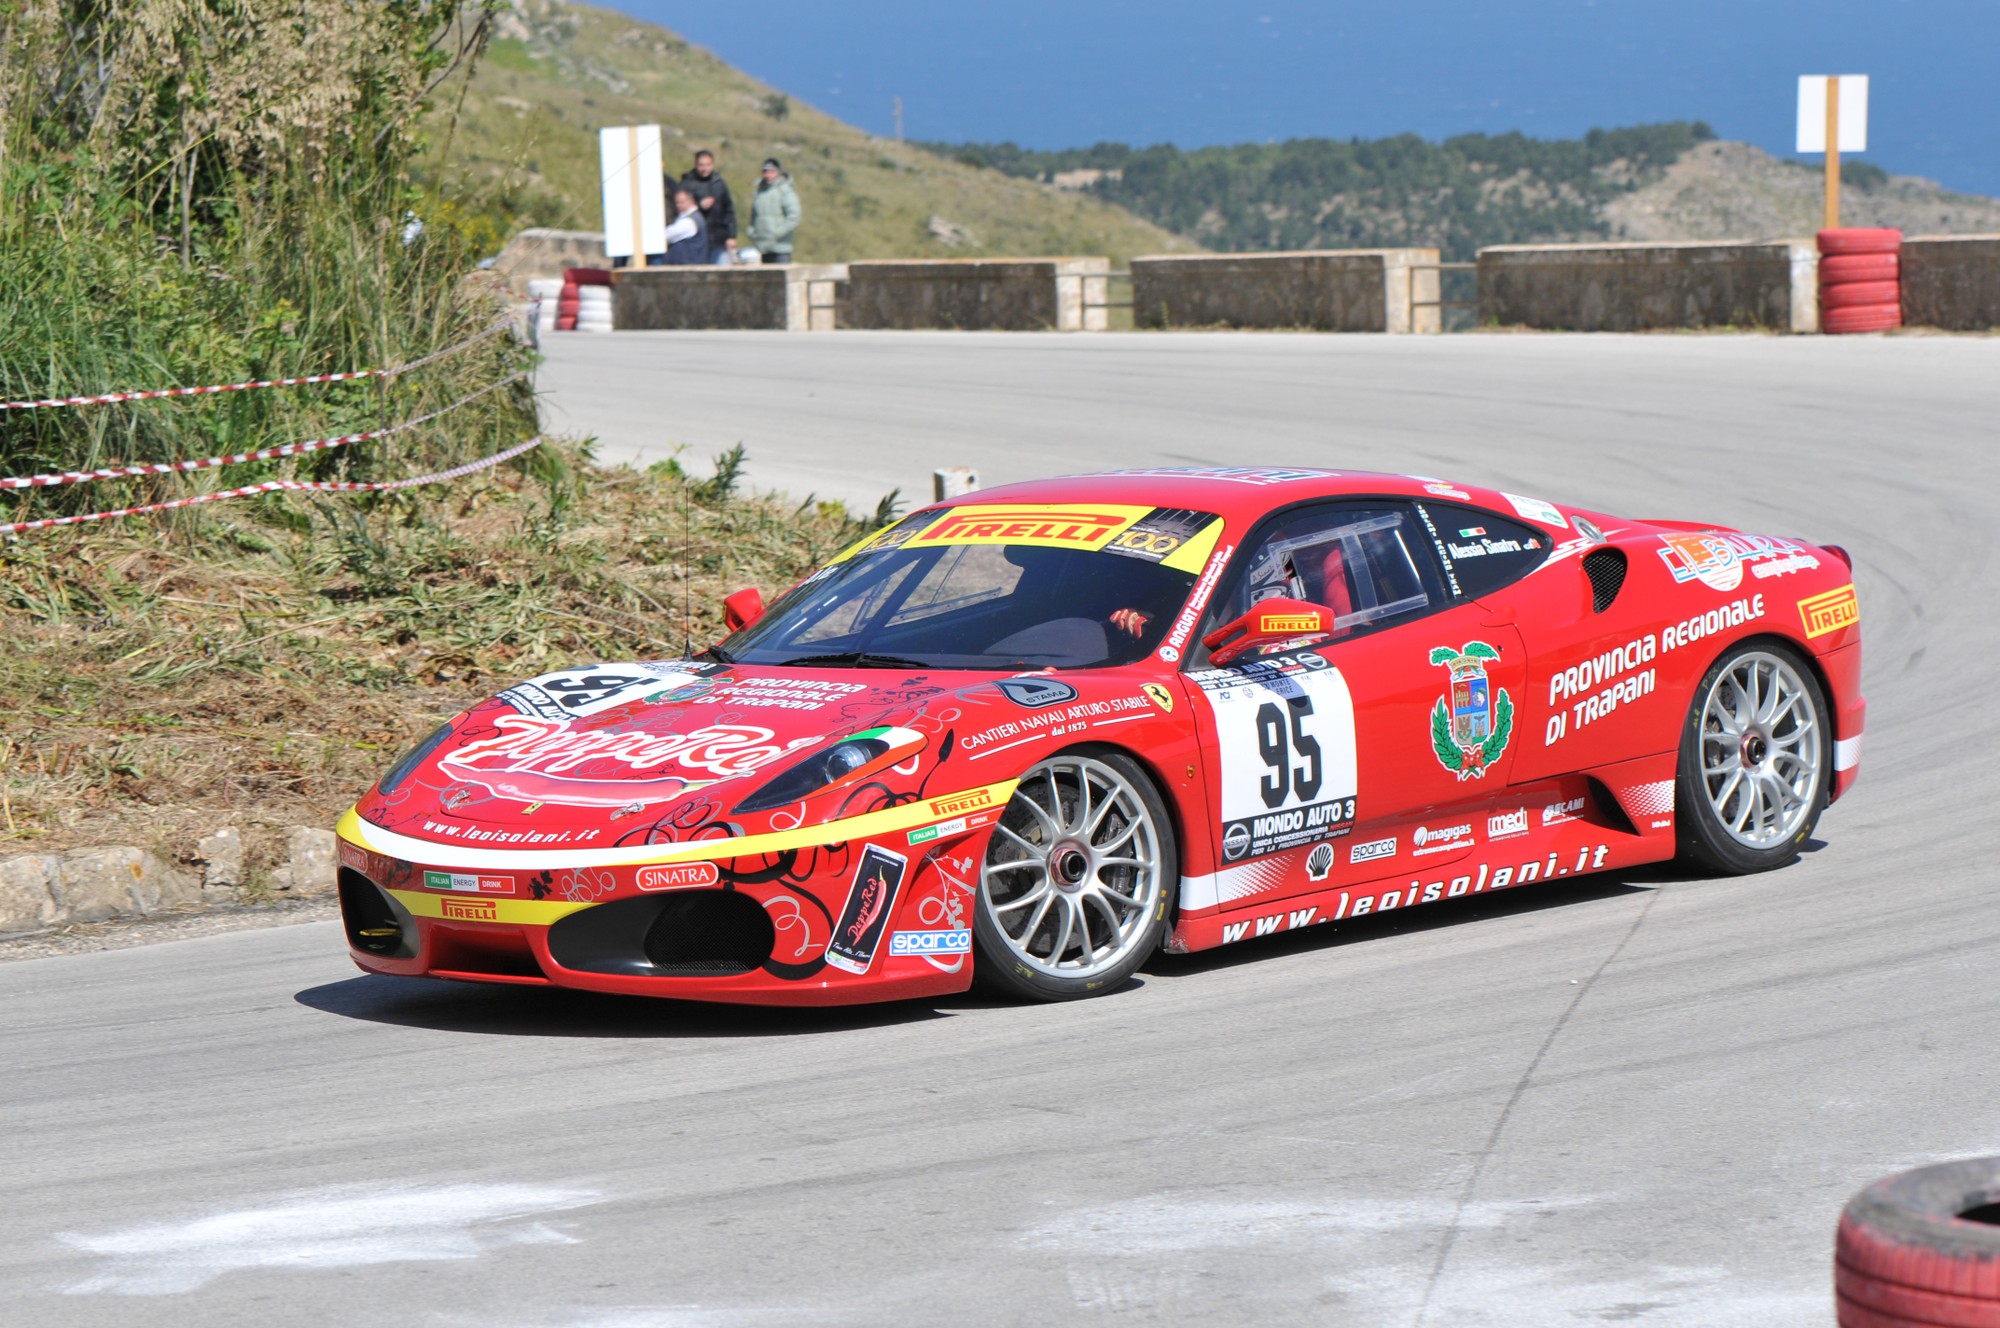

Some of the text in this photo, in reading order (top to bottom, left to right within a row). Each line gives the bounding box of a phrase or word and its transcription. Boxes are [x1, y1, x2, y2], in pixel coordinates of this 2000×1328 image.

[919, 512, 1127, 542] PIRELLI
[1114, 531, 1179, 553] 100
[1447, 541, 1487, 560] Alessia
[1481, 538, 1522, 555] Sinatra
[1801, 588, 1859, 634] PIRELLI
[1263, 616, 1318, 631] PIRELLI
[1278, 656, 1297, 666] 3
[1549, 633, 1657, 707] PROVINCIA
[1661, 593, 1765, 654] REGIONALE
[735, 678, 868, 693] PROVINCIA
[1270, 678, 1291, 688] MONTE
[693, 696, 825, 711] DI TRAPANI
[715, 687, 848, 702] REGIONALE
[1026, 690, 1067, 704] STAMA
[1545, 710, 1568, 747] DI
[1573, 667, 1656, 730] TRAPANI
[961, 695, 1151, 750] CANTIERI NAVALI ARTURO STABILE
[1051, 721, 1087, 737] dal 1875
[1256, 694, 1323, 809] 95
[929, 788, 992, 817] PIRELLI
[912, 815, 989, 841] ITALIAN ENERGY DRINK
[1253, 799, 1356, 839] MONDO AUTO 3
[423, 820, 601, 843] www.leoisolani.it
[1427, 823, 1472, 842] magigas
[1352, 838, 1396, 860] sparco
[430, 876, 502, 889] ITALIAN ENERGY DRINK
[644, 867, 710, 887] SINATRA
[1221, 844, 1610, 945] www.leoisolani.it
[440, 897, 497, 920] PIRELLI
[893, 931, 970, 954] sparco
